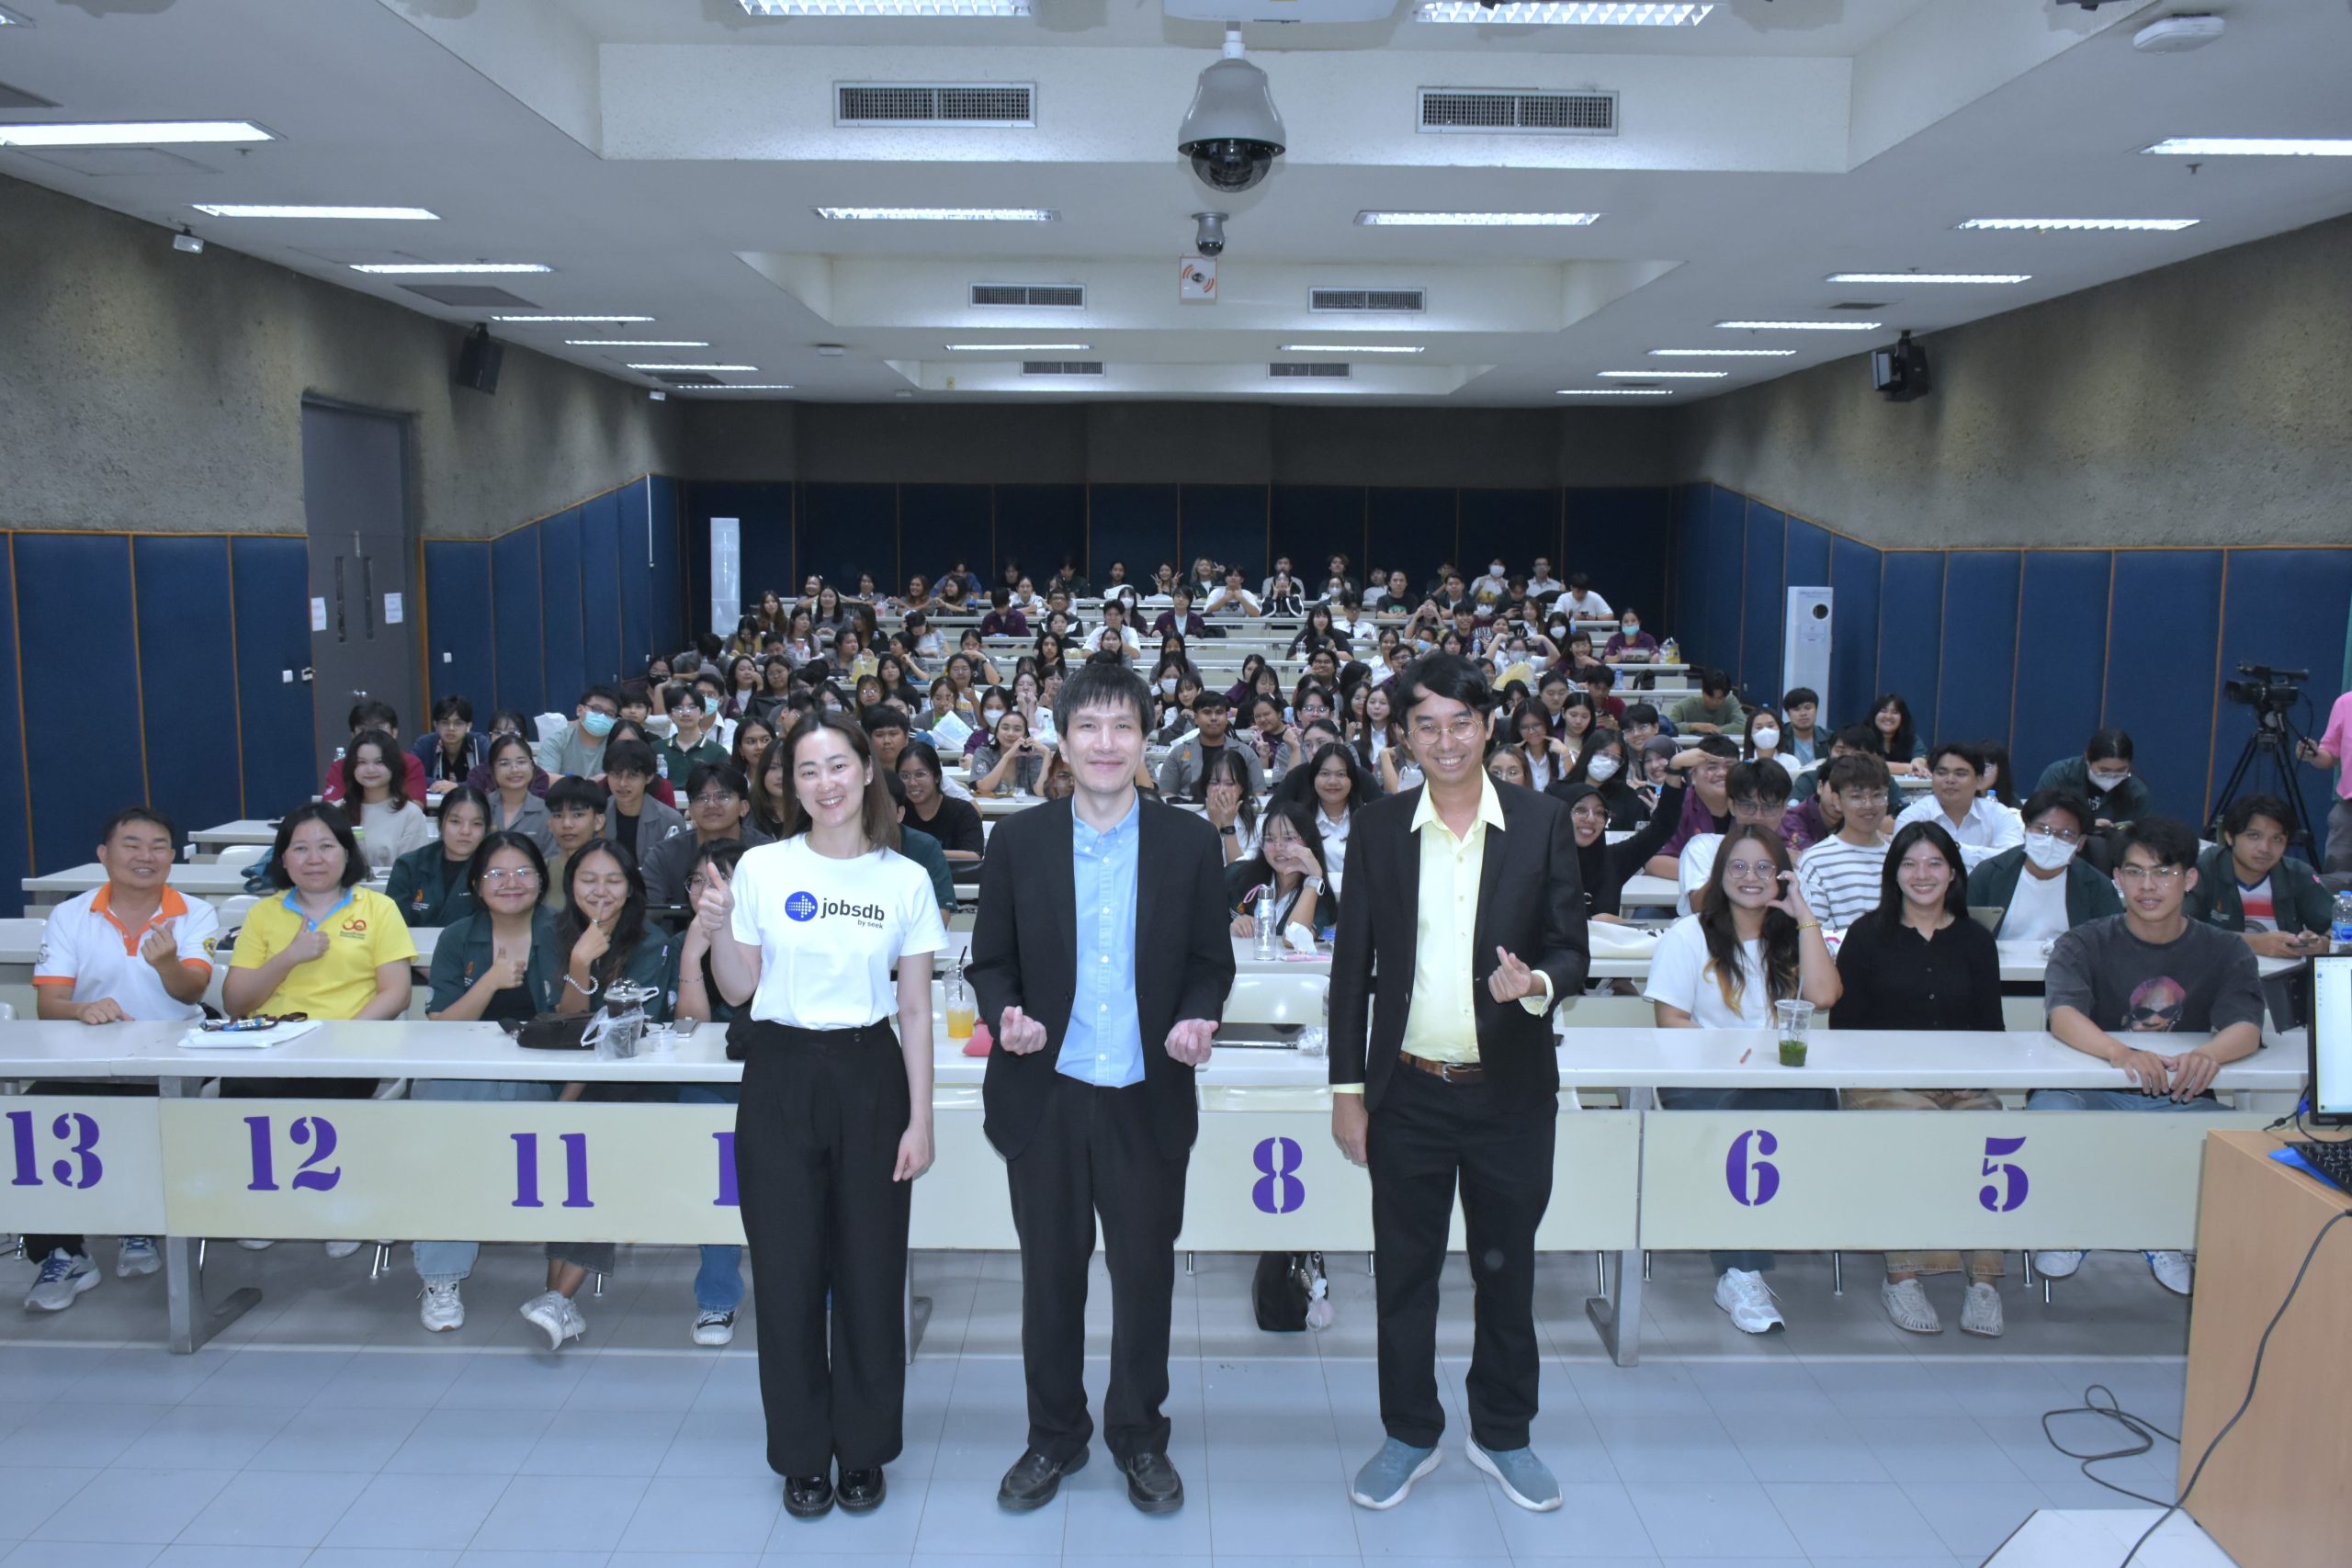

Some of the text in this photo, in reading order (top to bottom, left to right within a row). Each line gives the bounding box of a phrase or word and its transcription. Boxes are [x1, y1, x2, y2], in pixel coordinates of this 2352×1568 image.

[820, 897, 885, 921] jobsdb
[867, 921, 884, 930] seek
[6, 1111, 104, 1190] 13
[244, 1116, 342, 1191] 12
[510, 1133, 595, 1208] 11
[712, 1132, 741, 1207] 1
[1251, 1136, 1306, 1214] 8
[1725, 1129, 1781, 1207] 6
[1978, 1136, 2030, 1213] 5
